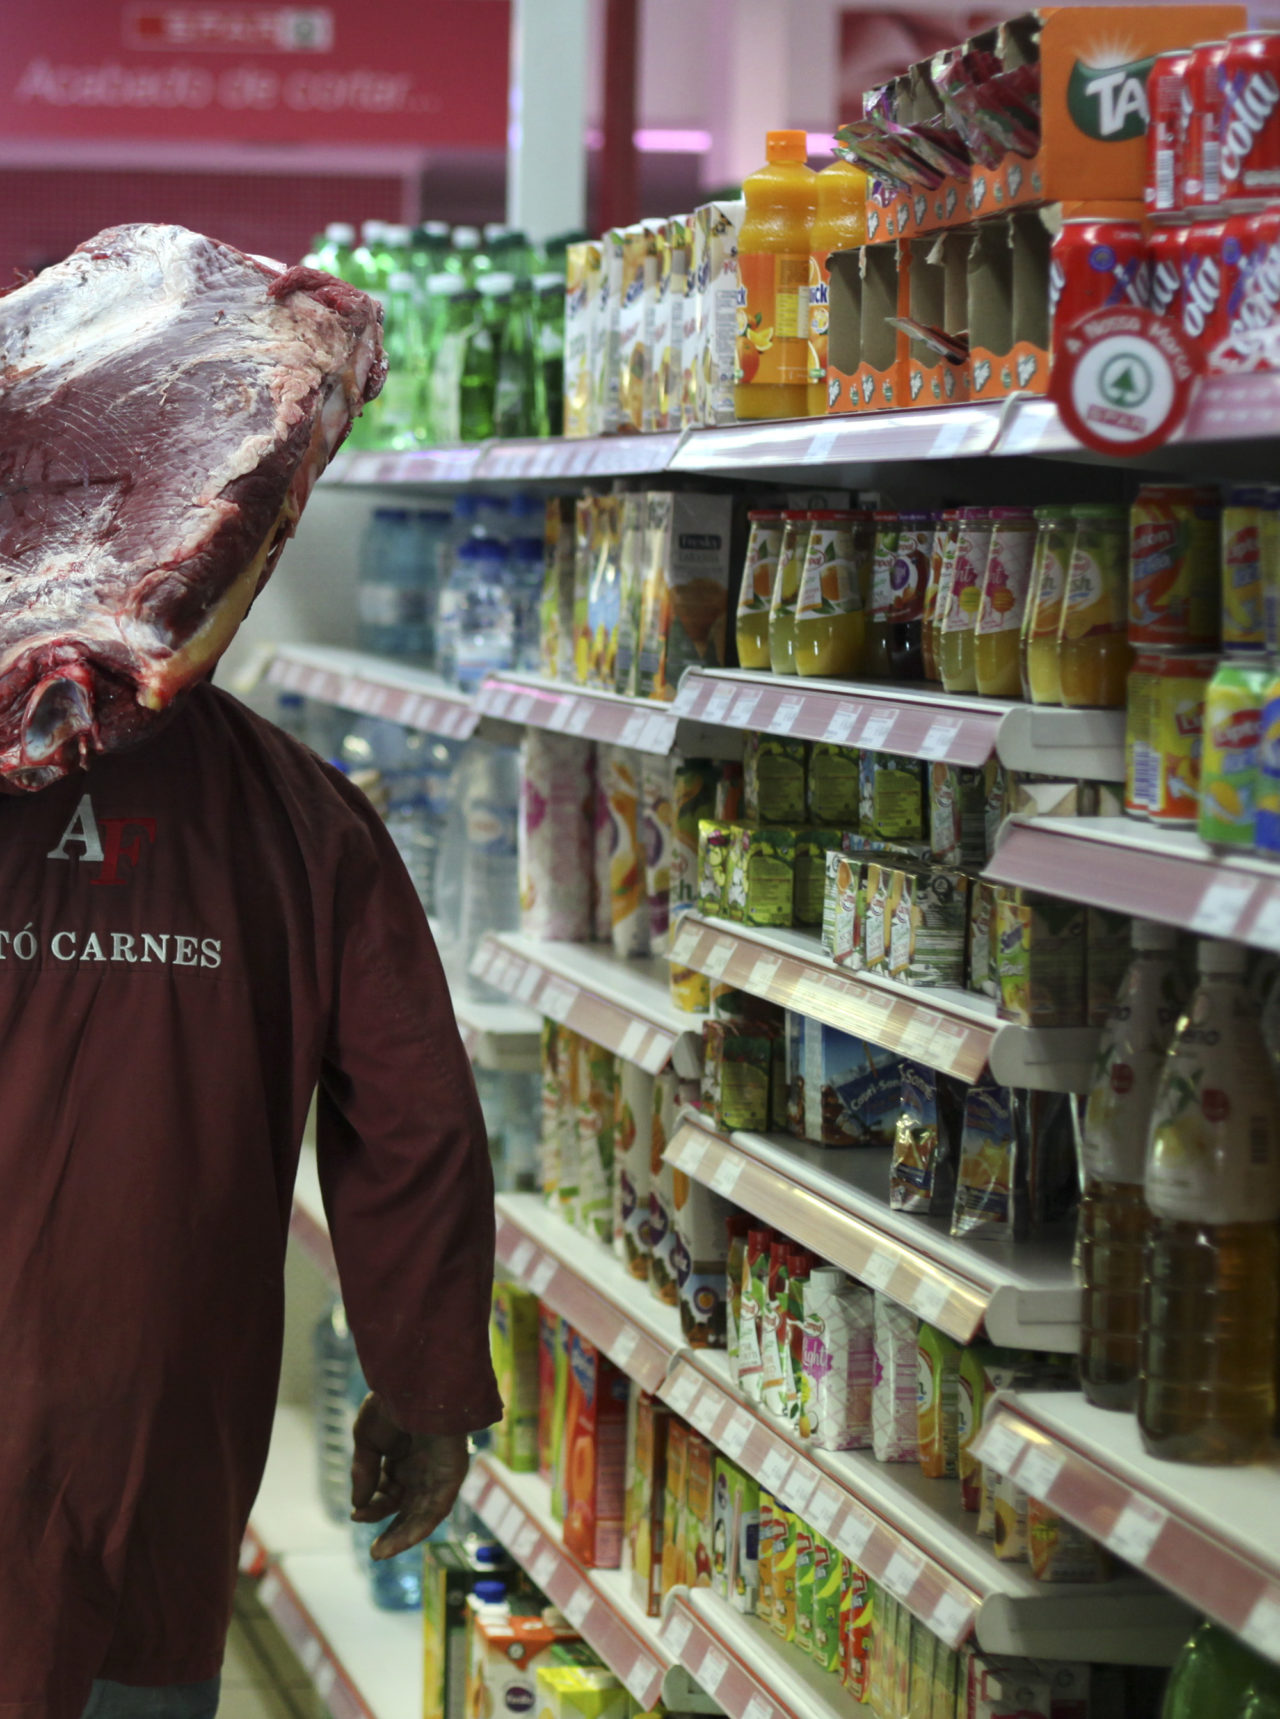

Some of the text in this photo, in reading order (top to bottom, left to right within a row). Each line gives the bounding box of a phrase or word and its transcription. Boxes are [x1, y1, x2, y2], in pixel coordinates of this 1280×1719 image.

[1086, 70, 1149, 137] TA
[47, 793, 157, 885] AF
[51, 931, 222, 968] CARNES
